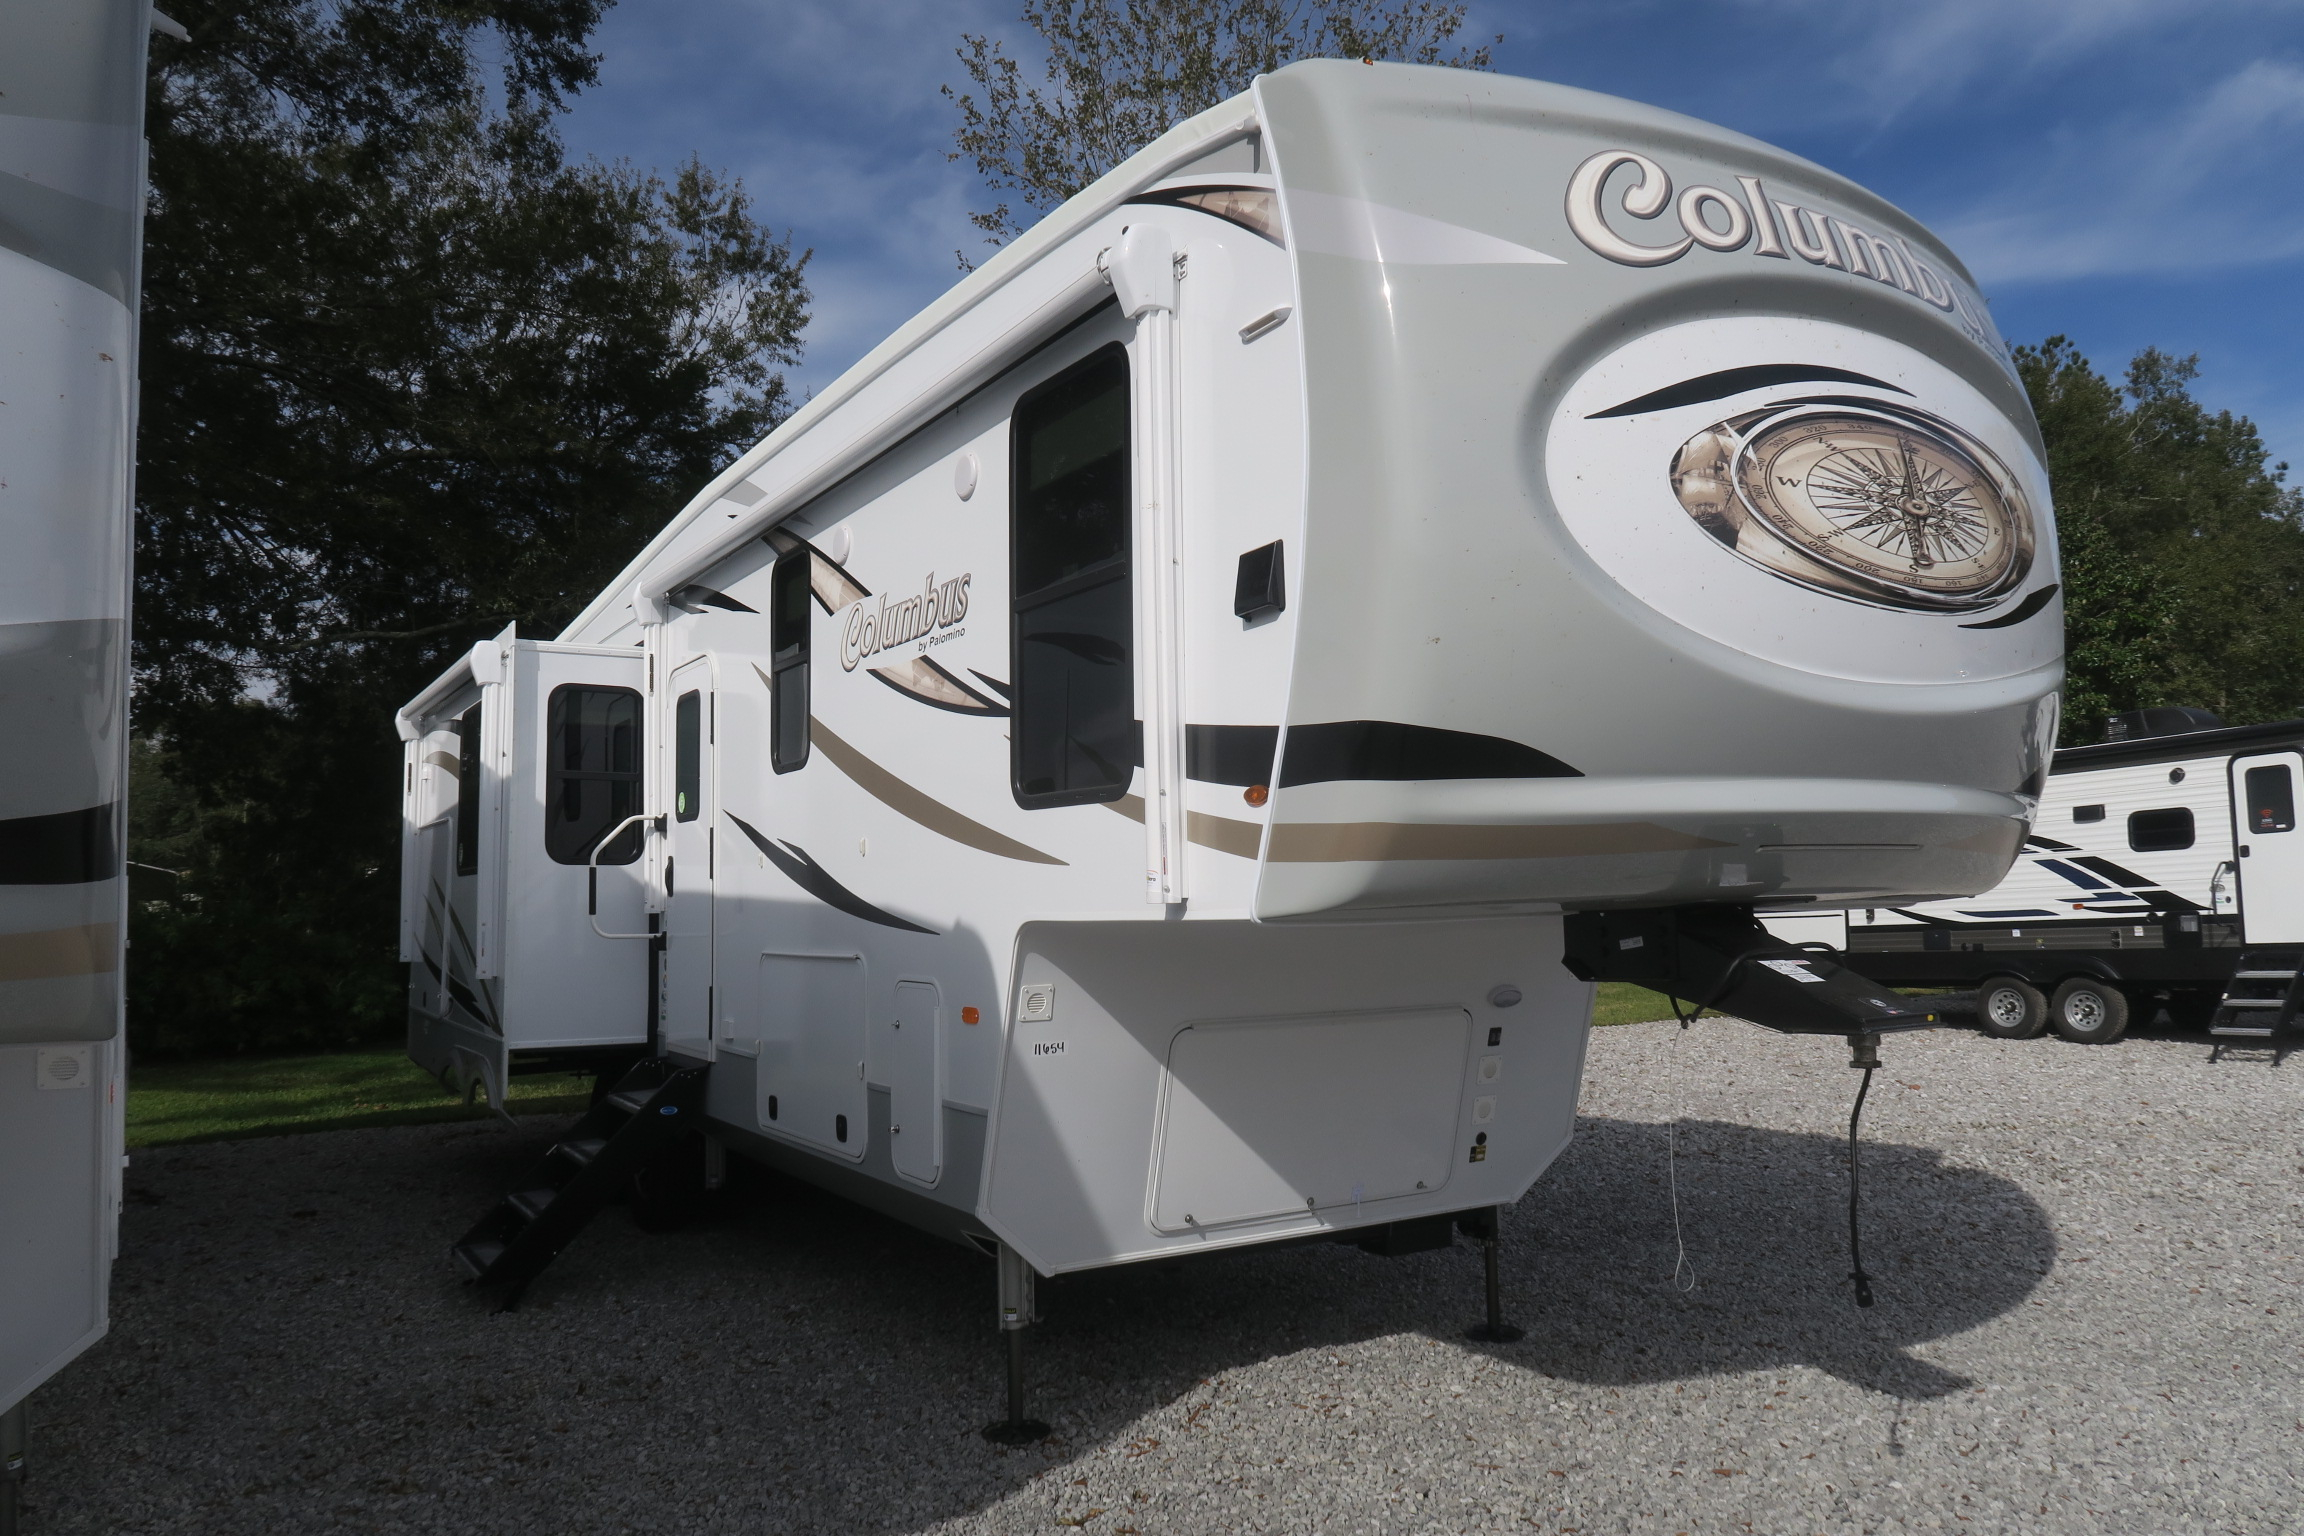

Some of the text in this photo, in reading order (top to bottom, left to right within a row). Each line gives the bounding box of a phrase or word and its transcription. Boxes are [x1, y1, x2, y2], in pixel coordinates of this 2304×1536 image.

[1802, 425, 1827, 434] 320
[1776, 475, 1802, 488] W
[1808, 540, 1834, 555] 220
[1855, 562, 1881, 574] 200
[1908, 564, 1919, 574] S
[840, 571, 971, 672] Columbus
[918, 627, 966, 653] by Palomino
[1034, 1041, 1065, 1056] 11654
